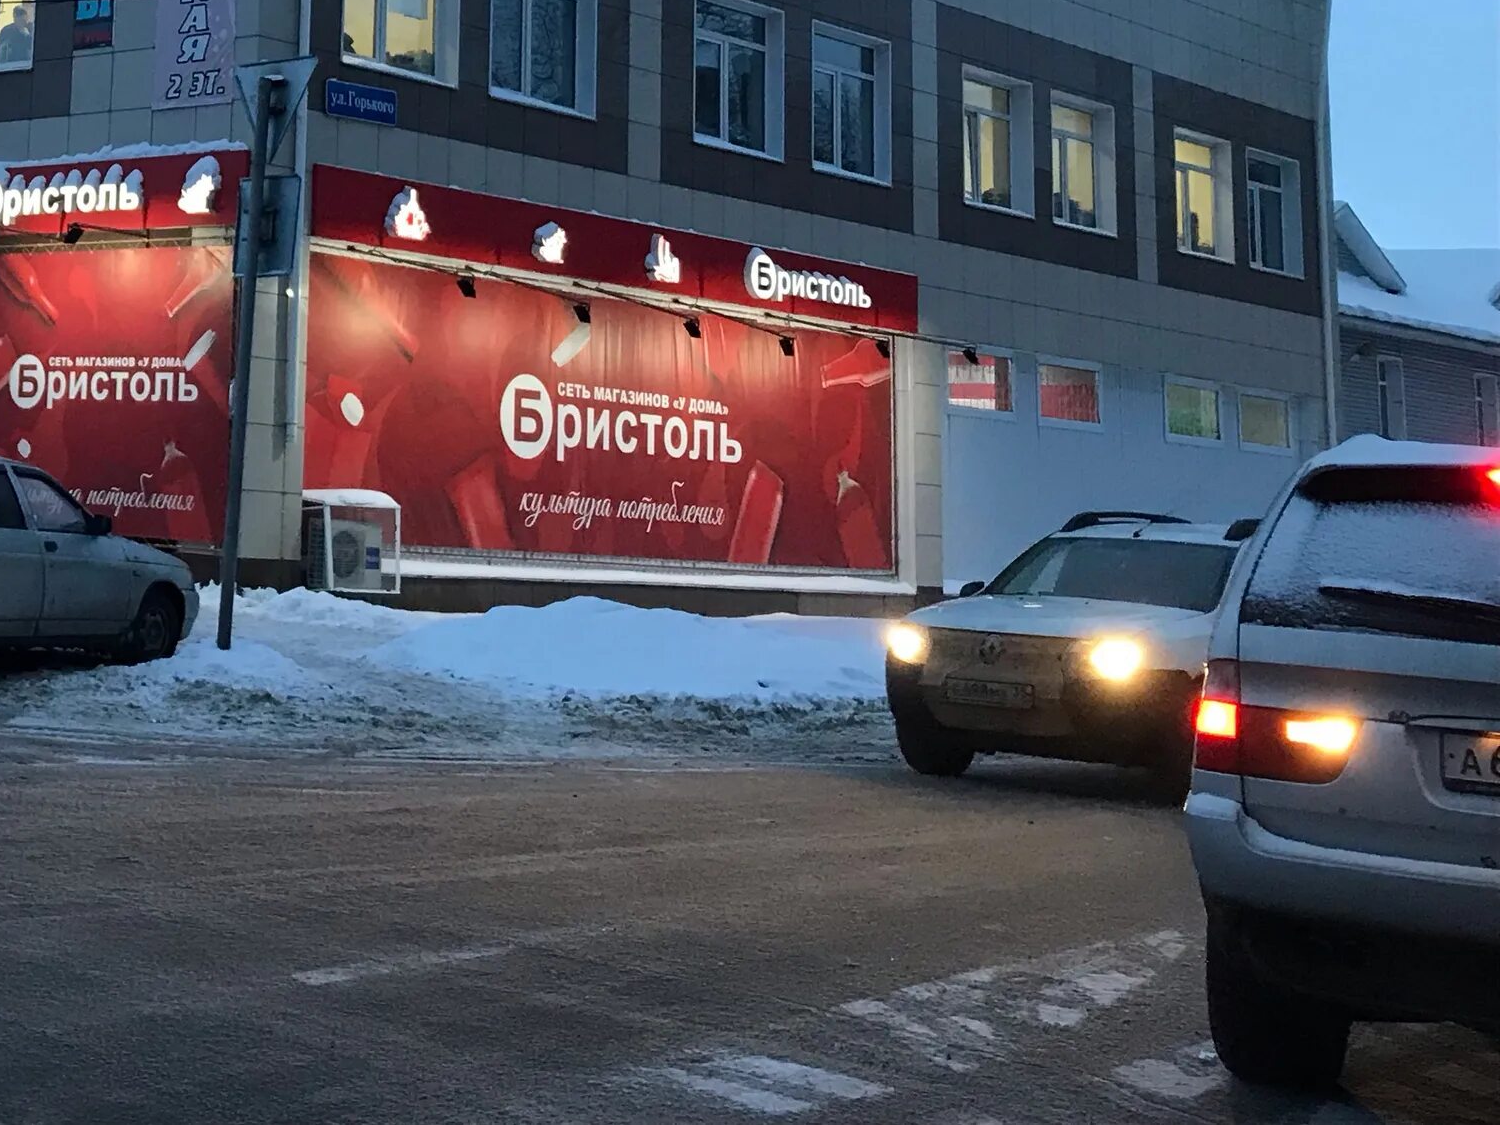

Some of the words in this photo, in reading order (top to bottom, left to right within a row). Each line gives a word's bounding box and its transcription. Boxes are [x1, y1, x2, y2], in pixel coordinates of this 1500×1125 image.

[165, 74, 183, 100] 2
[188, 69, 226, 97] ЭТ.
[750, 254, 872, 309] Бристоль
[9, 354, 199, 409] Бристоль
[48, 357, 73, 367] СЕТЬ
[75, 356, 135, 367] МАГАЗИНОВ
[500, 373, 743, 464] Бристоль
[557, 382, 591, 399] СЕТЬ
[593, 387, 670, 409] МАГАЗИНОВ
[673, 397, 686, 411] «У
[688, 399, 729, 415] ДОМА»
[86, 473, 196, 517] потребления
[518, 491, 613, 530] культура
[616, 481, 726, 533] потребления
